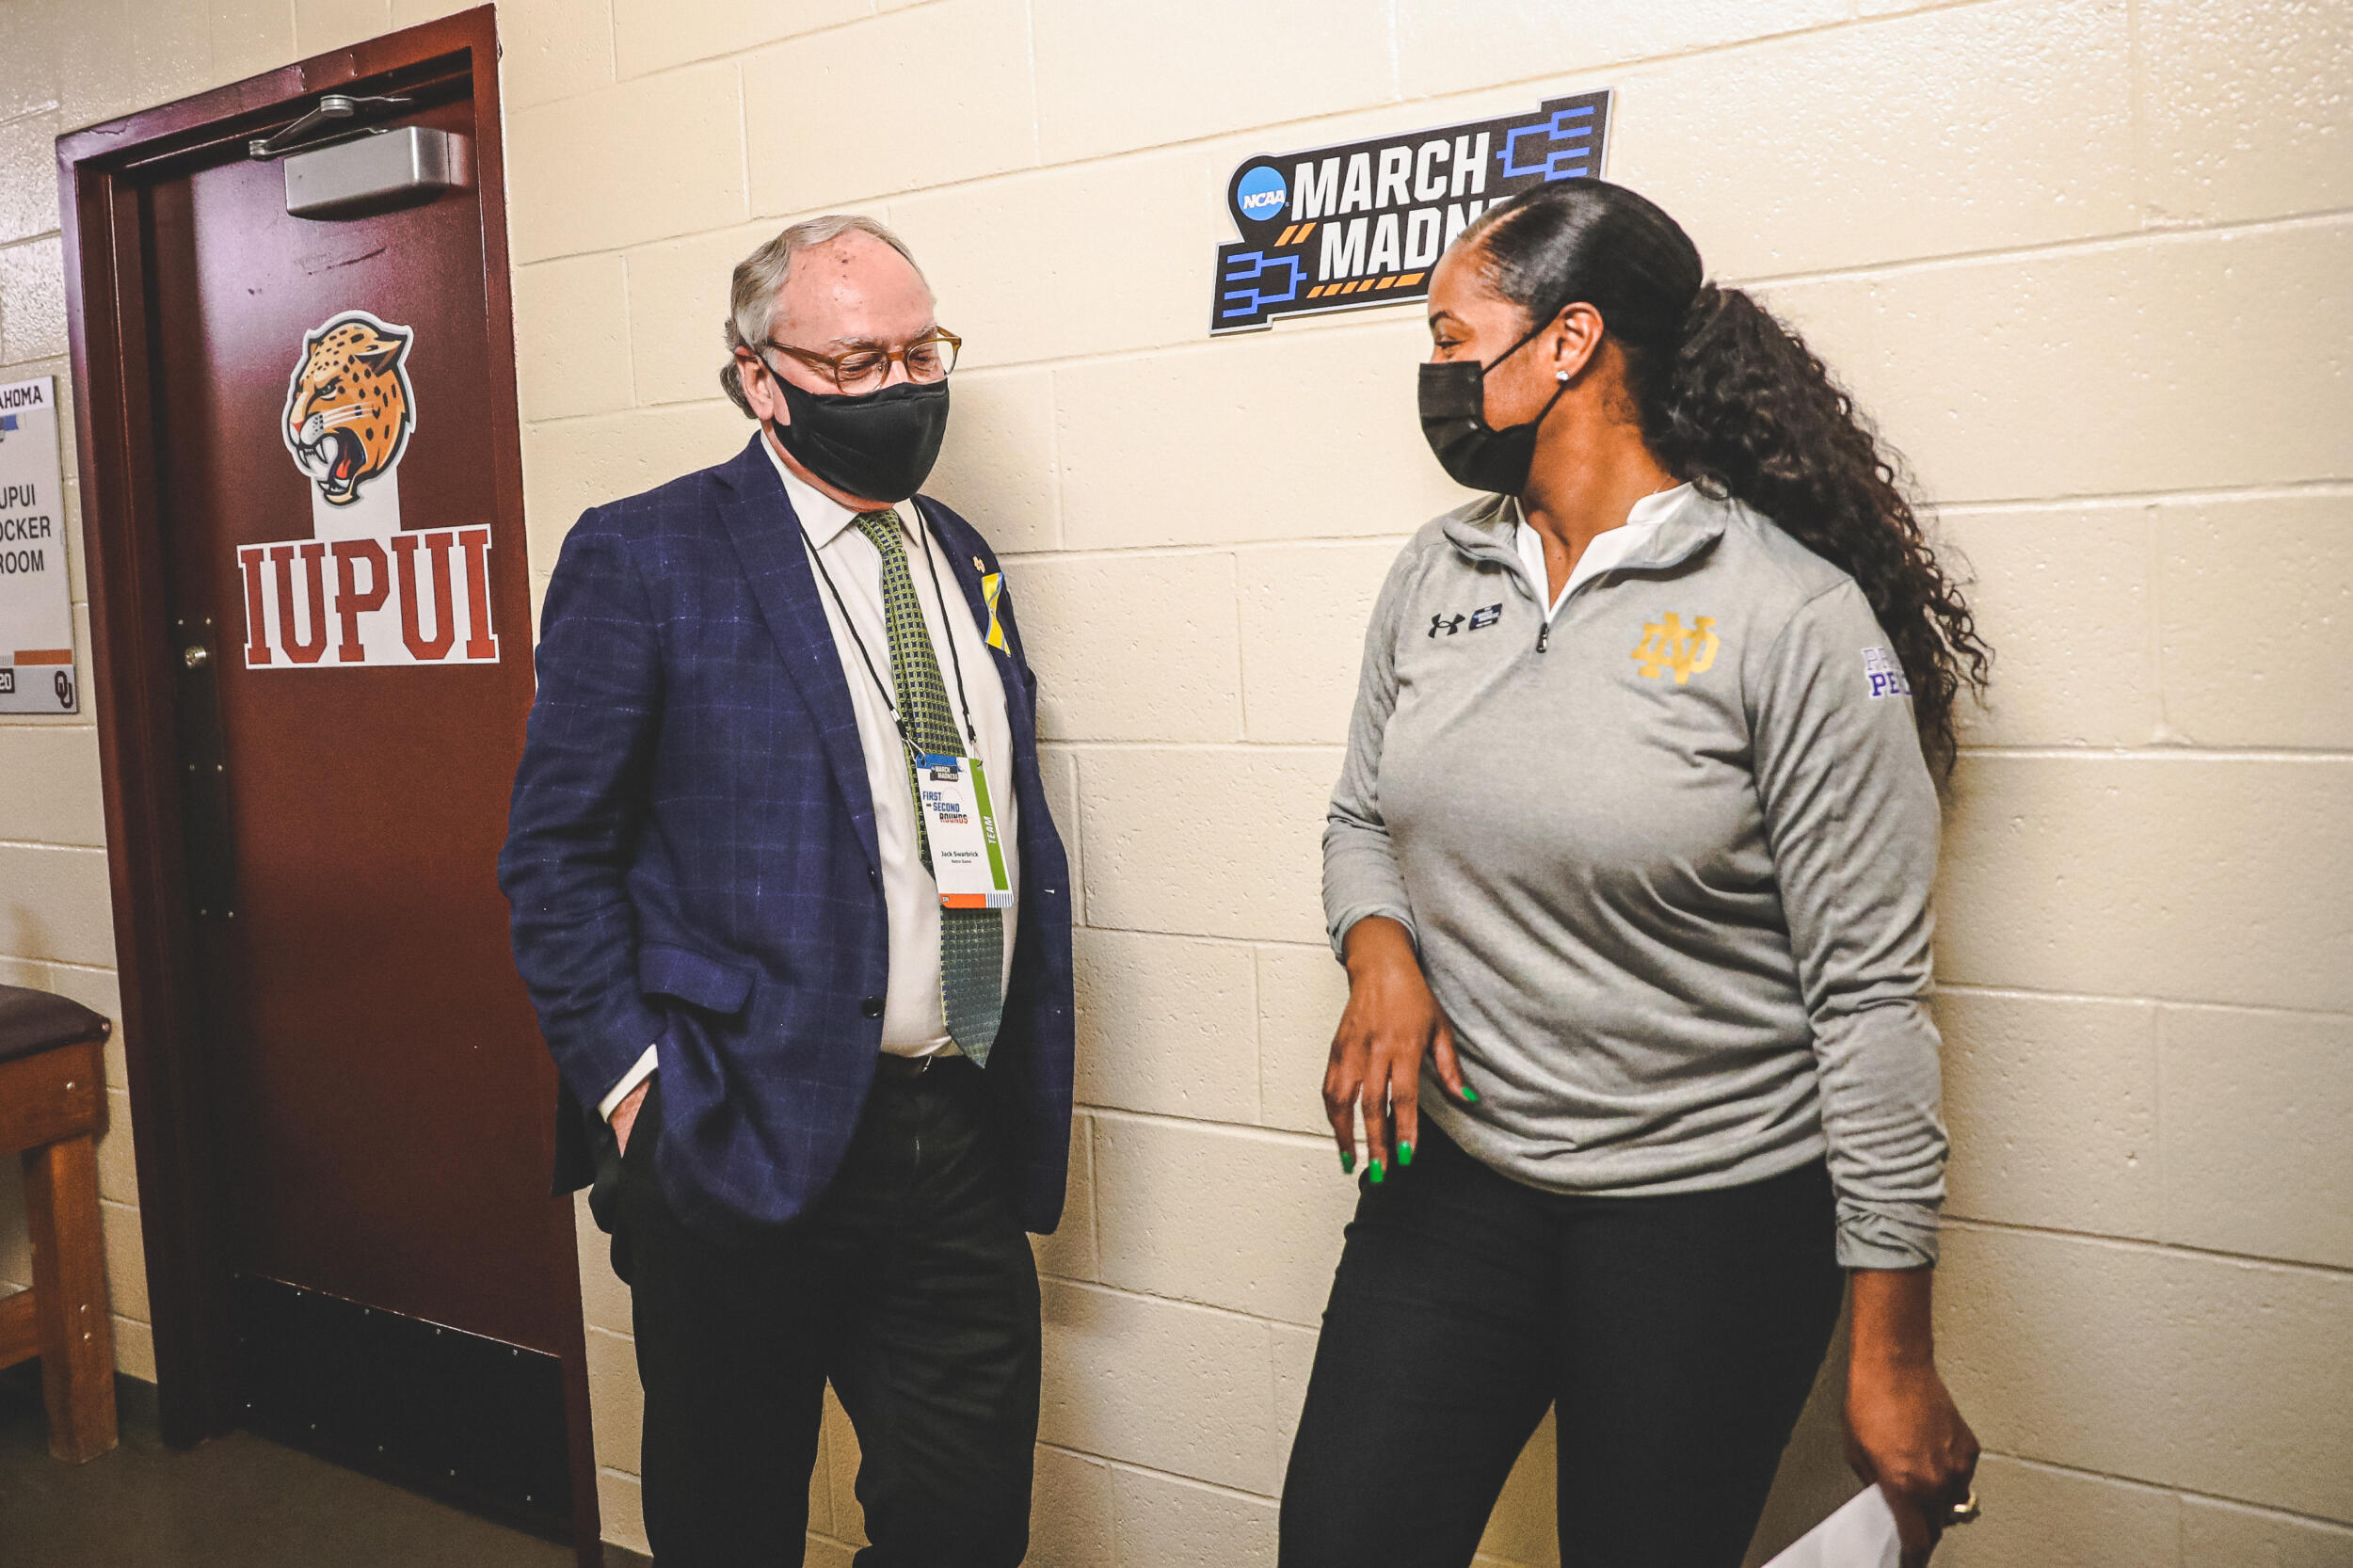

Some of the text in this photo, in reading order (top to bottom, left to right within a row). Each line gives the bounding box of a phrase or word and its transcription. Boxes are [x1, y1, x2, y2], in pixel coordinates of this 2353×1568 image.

[1291, 132, 1490, 221] MARCH
[1243, 189, 1286, 209] NCAA
[1319, 195, 1514, 281] MADN
[241, 529, 496, 664] IUPUI
[922, 791, 942, 801] FIRST
[933, 802, 960, 812] SECOND
[939, 813, 968, 824] ROUNDS
[984, 815, 997, 844] TEAM
